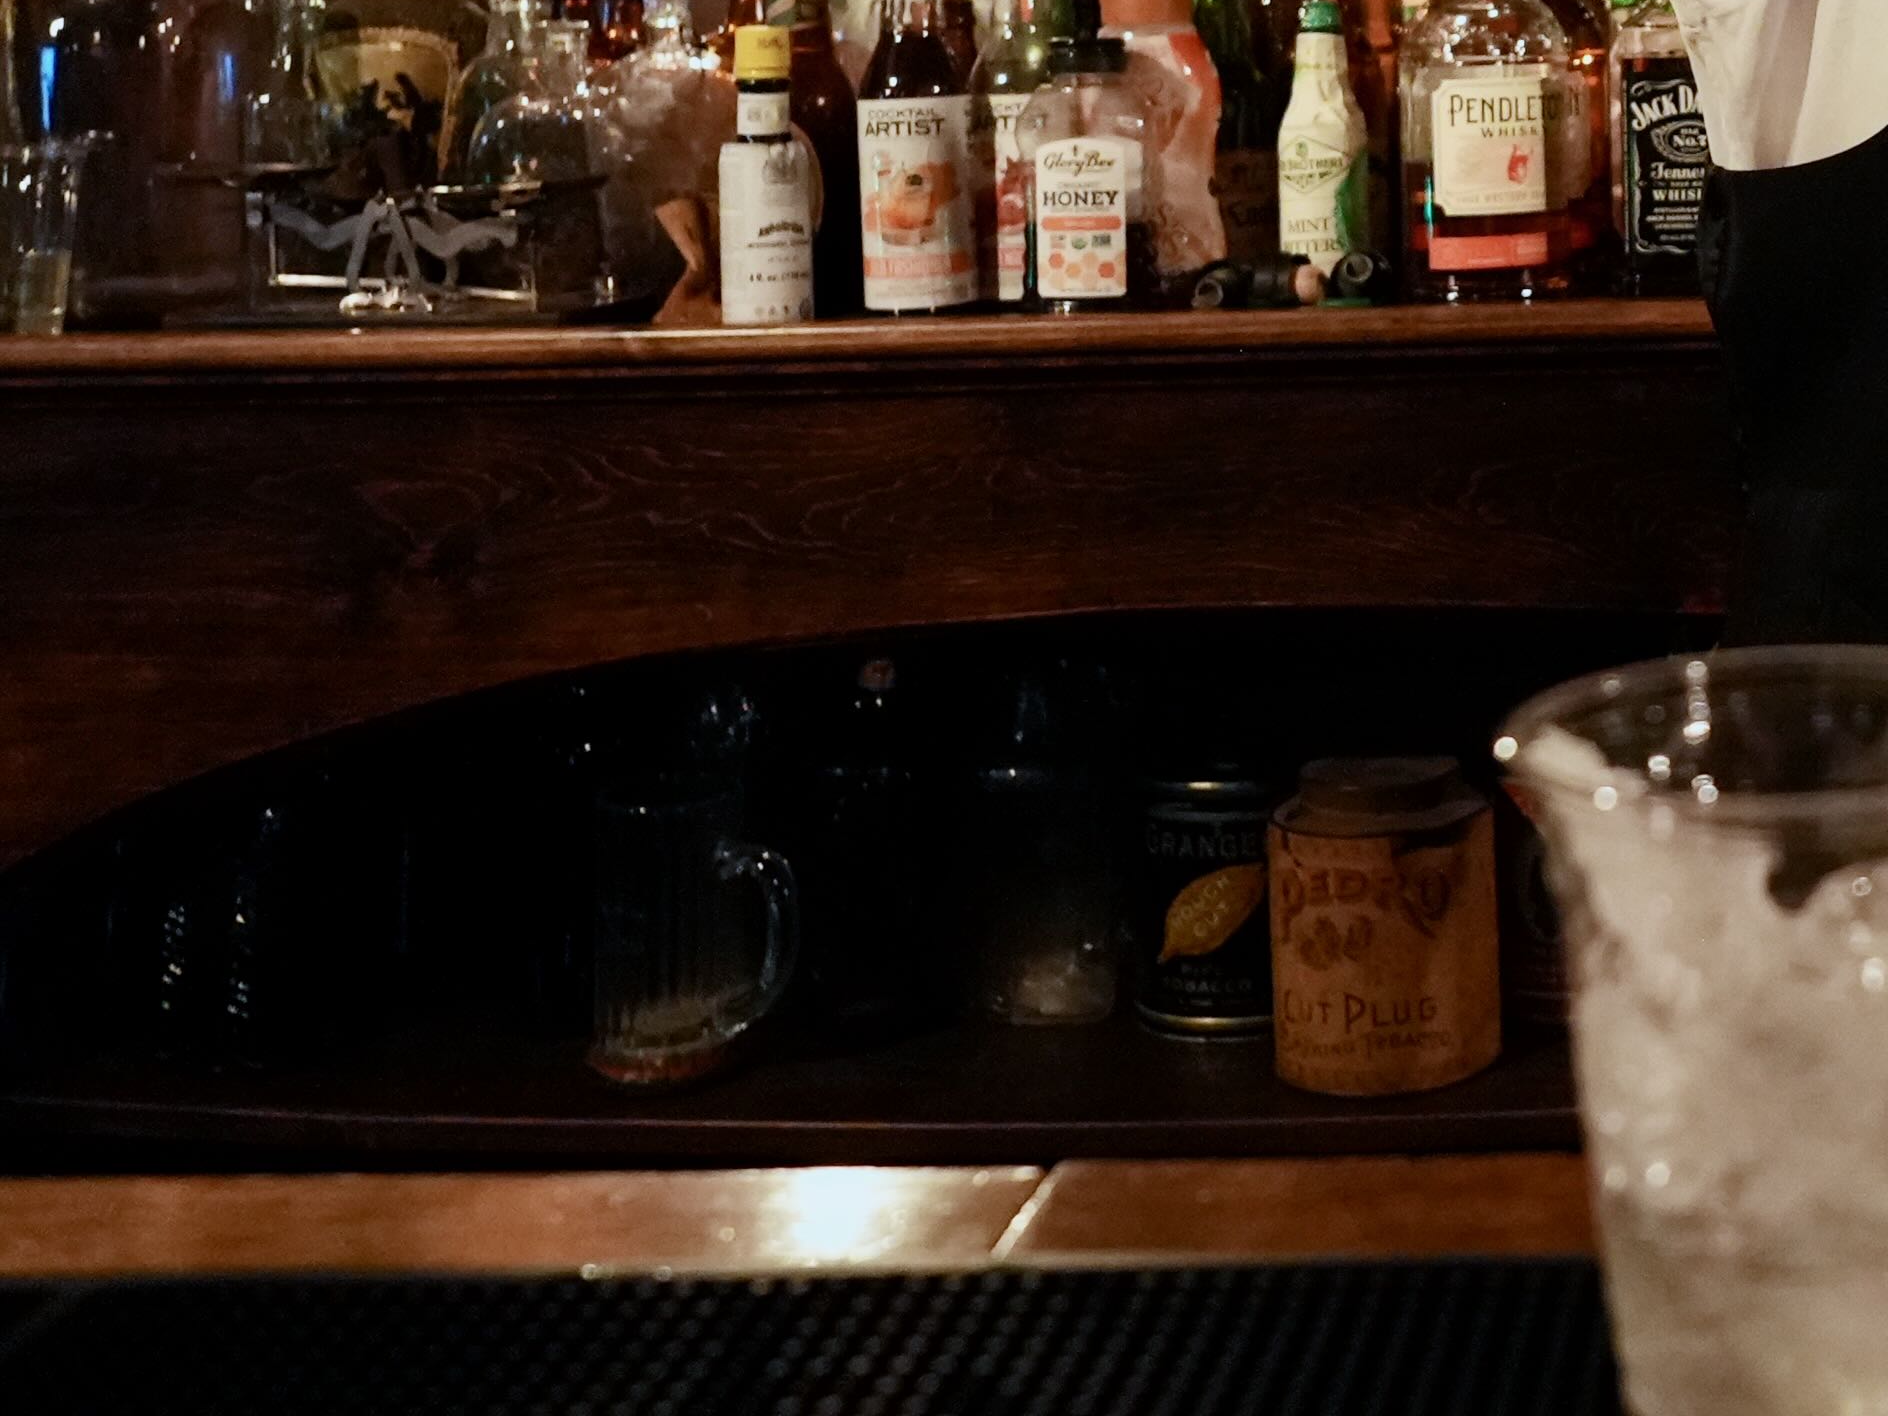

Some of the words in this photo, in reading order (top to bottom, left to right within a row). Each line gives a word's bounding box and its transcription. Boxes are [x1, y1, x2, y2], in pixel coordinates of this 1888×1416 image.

[867, 107, 937, 121] COCKTAIL
[1631, 93, 1676, 132] JACK
[865, 117, 945, 138] ARTIST
[1481, 126, 1540, 138] WHISK
[1042, 189, 1118, 206] HONEY
[1652, 188, 1702, 202] WHIS
[1287, 216, 1332, 234] MINT
[1343, 991, 1438, 1034] PLUG
